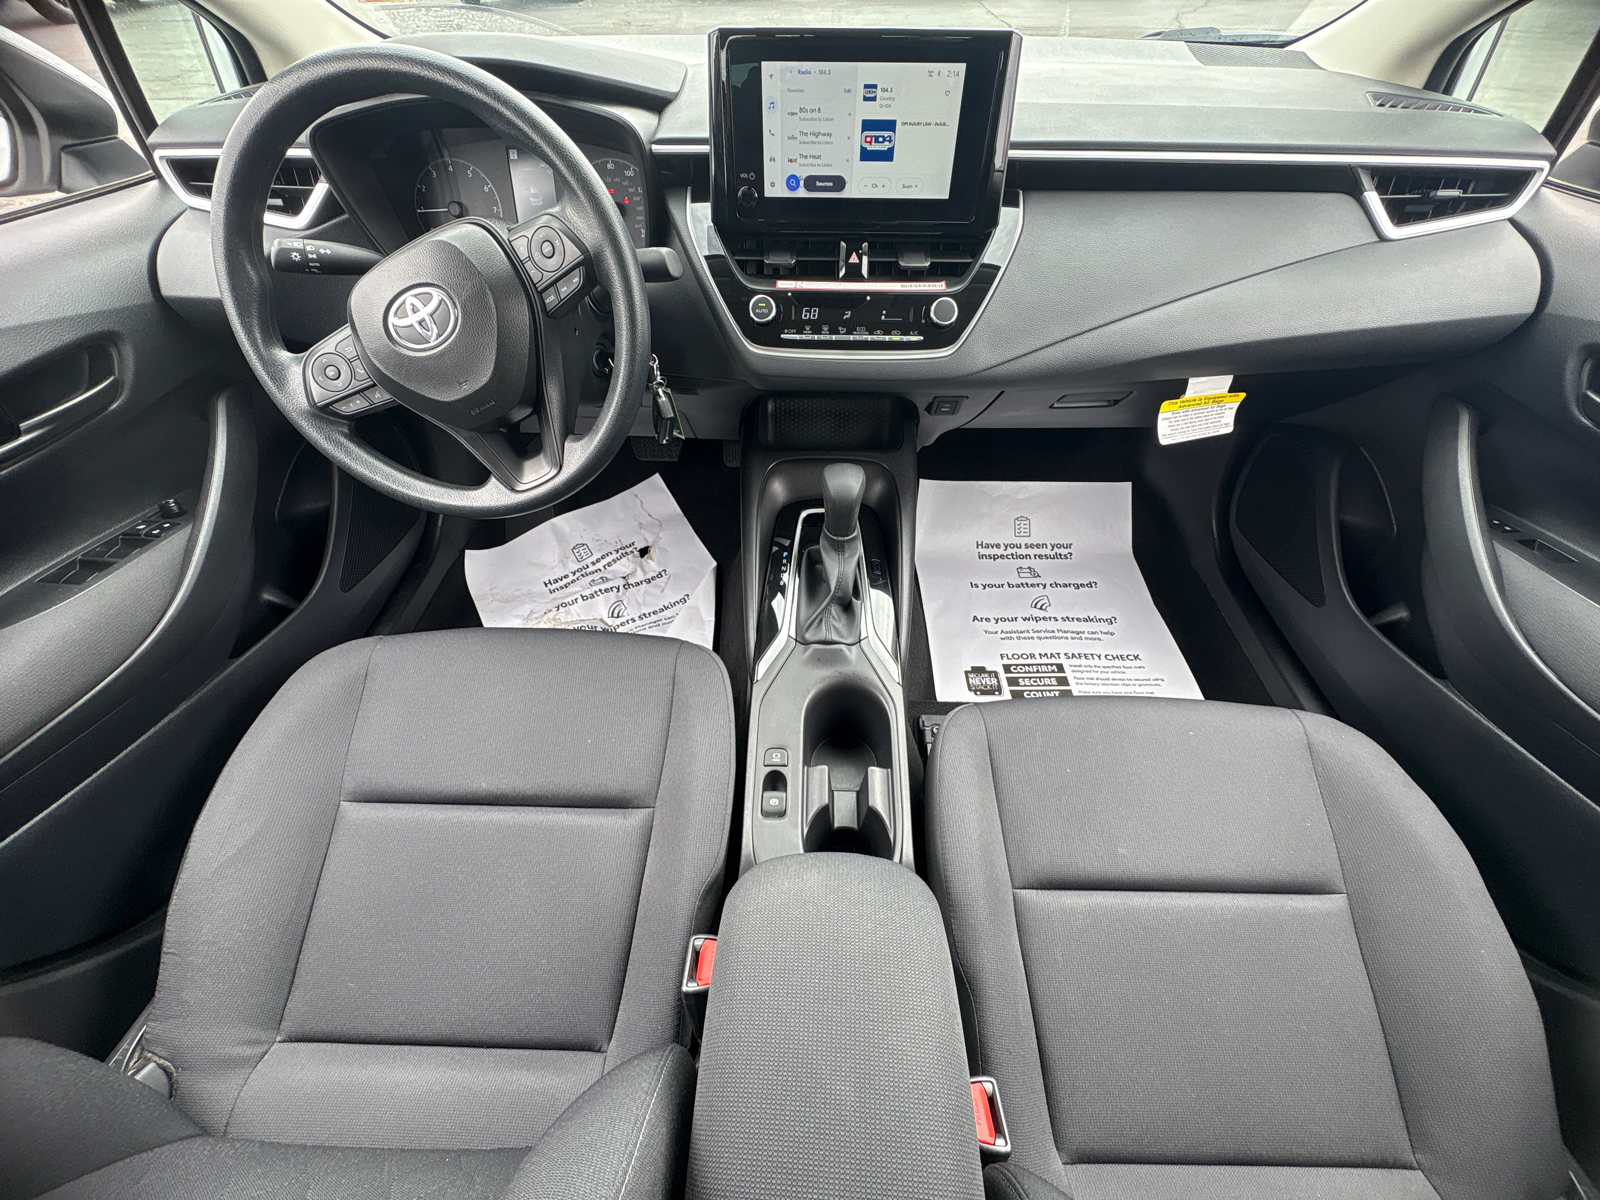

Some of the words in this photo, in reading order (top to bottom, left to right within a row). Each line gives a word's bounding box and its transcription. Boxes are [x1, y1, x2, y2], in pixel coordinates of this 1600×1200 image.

[864, 135, 893, 145] Q104
[802, 308, 818, 319] 68
[976, 541, 1001, 549] Have
[1003, 543, 1022, 551] you
[1050, 543, 1073, 551] your
[978, 552, 1032, 561] inspection
[1034, 552, 1073, 560] results?
[544, 574, 569, 587] Have
[571, 564, 589, 576] you
[591, 551, 612, 566] seen
[613, 541, 635, 554] your
[549, 568, 602, 594] inspection
[603, 547, 638, 570] results?
[555, 598, 579, 611] your
[581, 585, 620, 602] battery
[623, 569, 668, 590] charged?
[982, 582, 1005, 590] your
[1007, 582, 1047, 590] battery
[1050, 581, 1098, 590] charged?
[638, 594, 690, 618] streaking?
[993, 616, 1019, 624] your
[1021, 614, 1058, 623] wipers
[1061, 616, 1117, 625] streaking?
